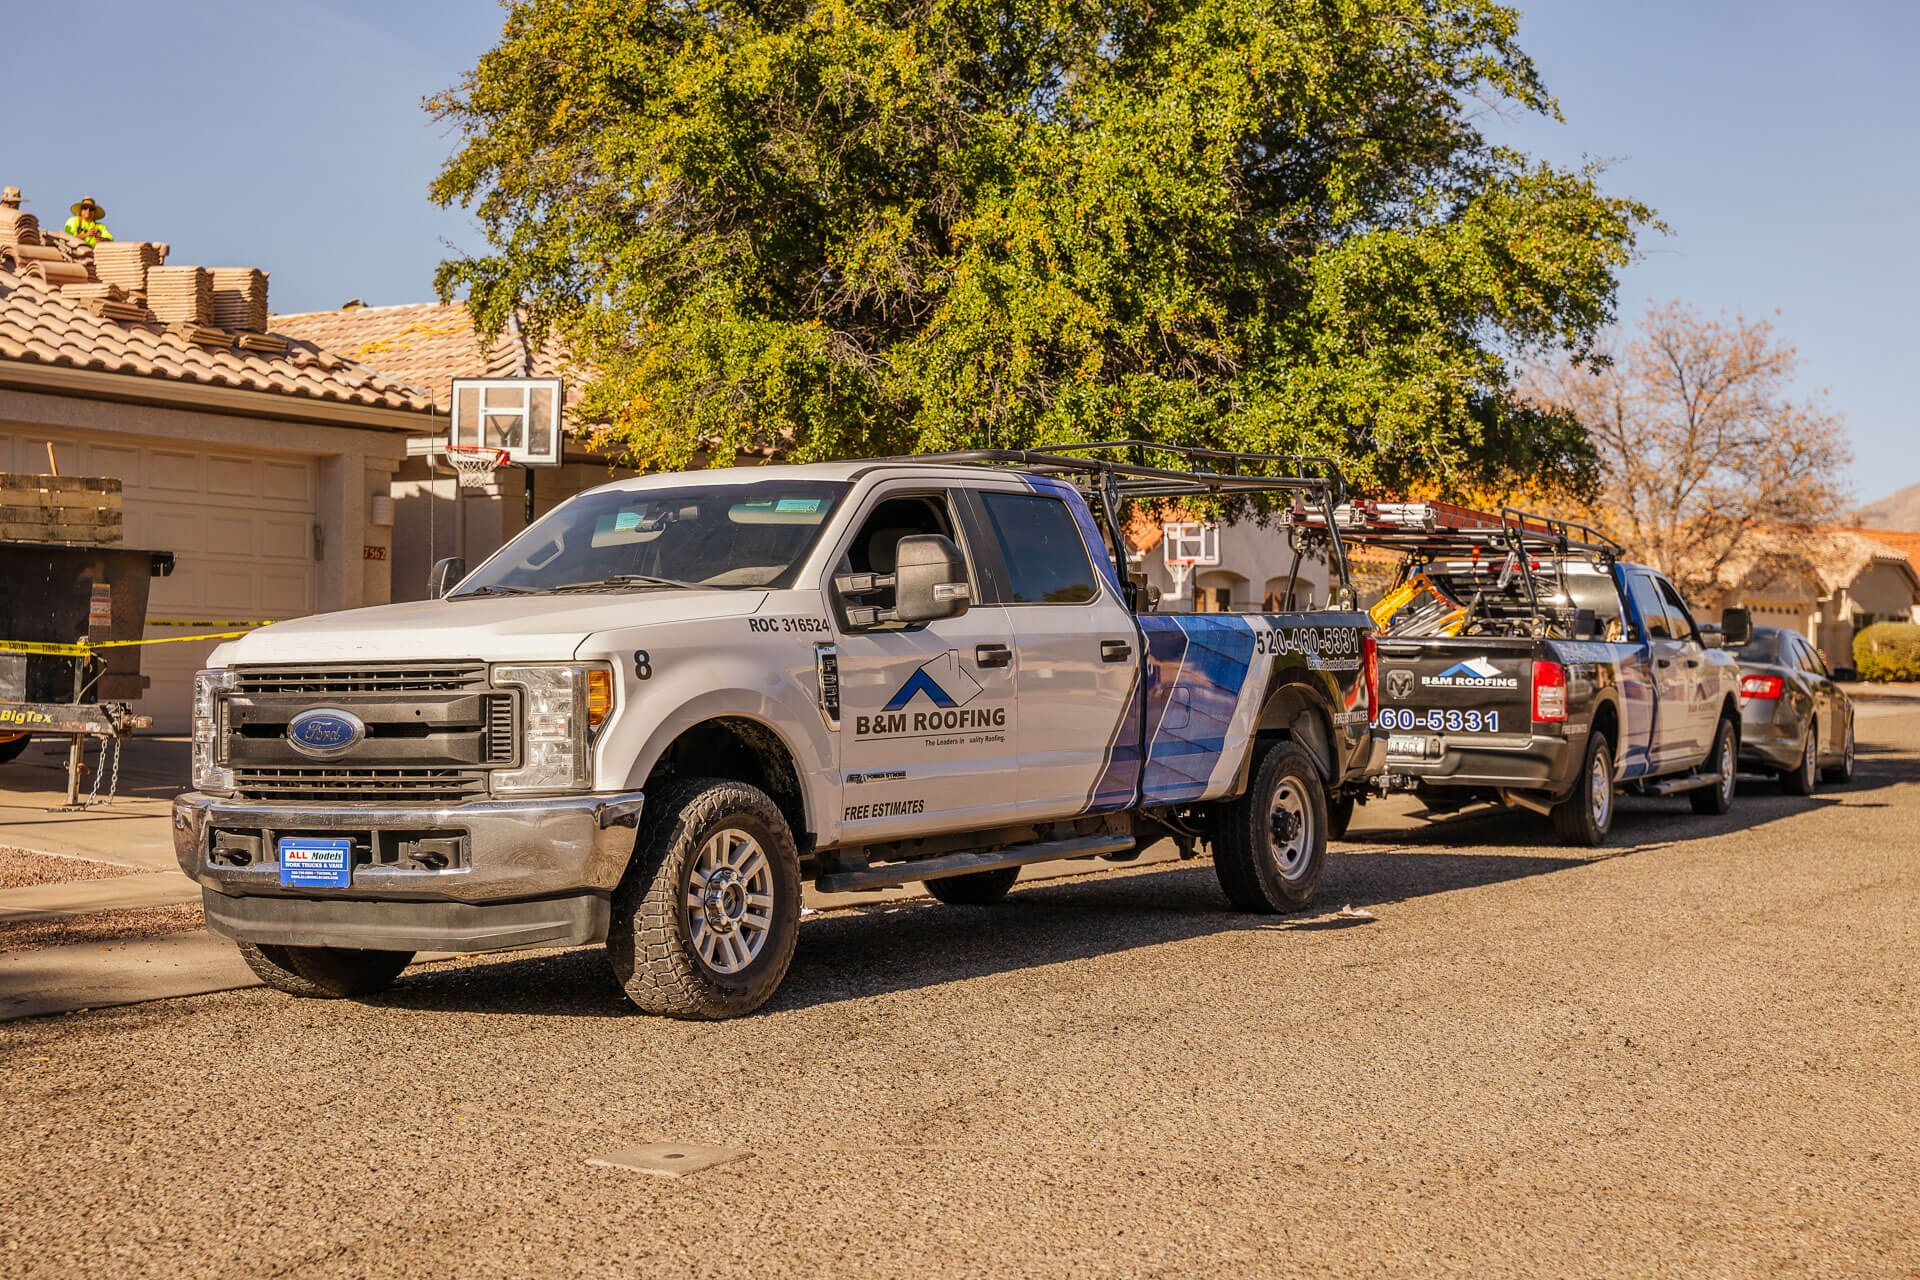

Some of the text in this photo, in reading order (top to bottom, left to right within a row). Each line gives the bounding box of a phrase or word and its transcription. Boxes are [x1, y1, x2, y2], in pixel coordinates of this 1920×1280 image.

[748, 618, 829, 632] ROC 316524
[1256, 627, 1359, 655] 520-460-5331
[634, 649, 652, 680] 8
[1421, 676, 1518, 687] B&M ROOFING
[856, 708, 1006, 735] B&M ROOFING
[1370, 708, 1498, 732] 60-5331
[305, 721, 341, 741] Ford
[925, 739, 935, 747] The
[936, 738, 958, 746] Leaders
[969, 736, 984, 744] uality
[844, 799, 925, 821] FREE ESTIMATES
[289, 851, 343, 861] ALL Models
